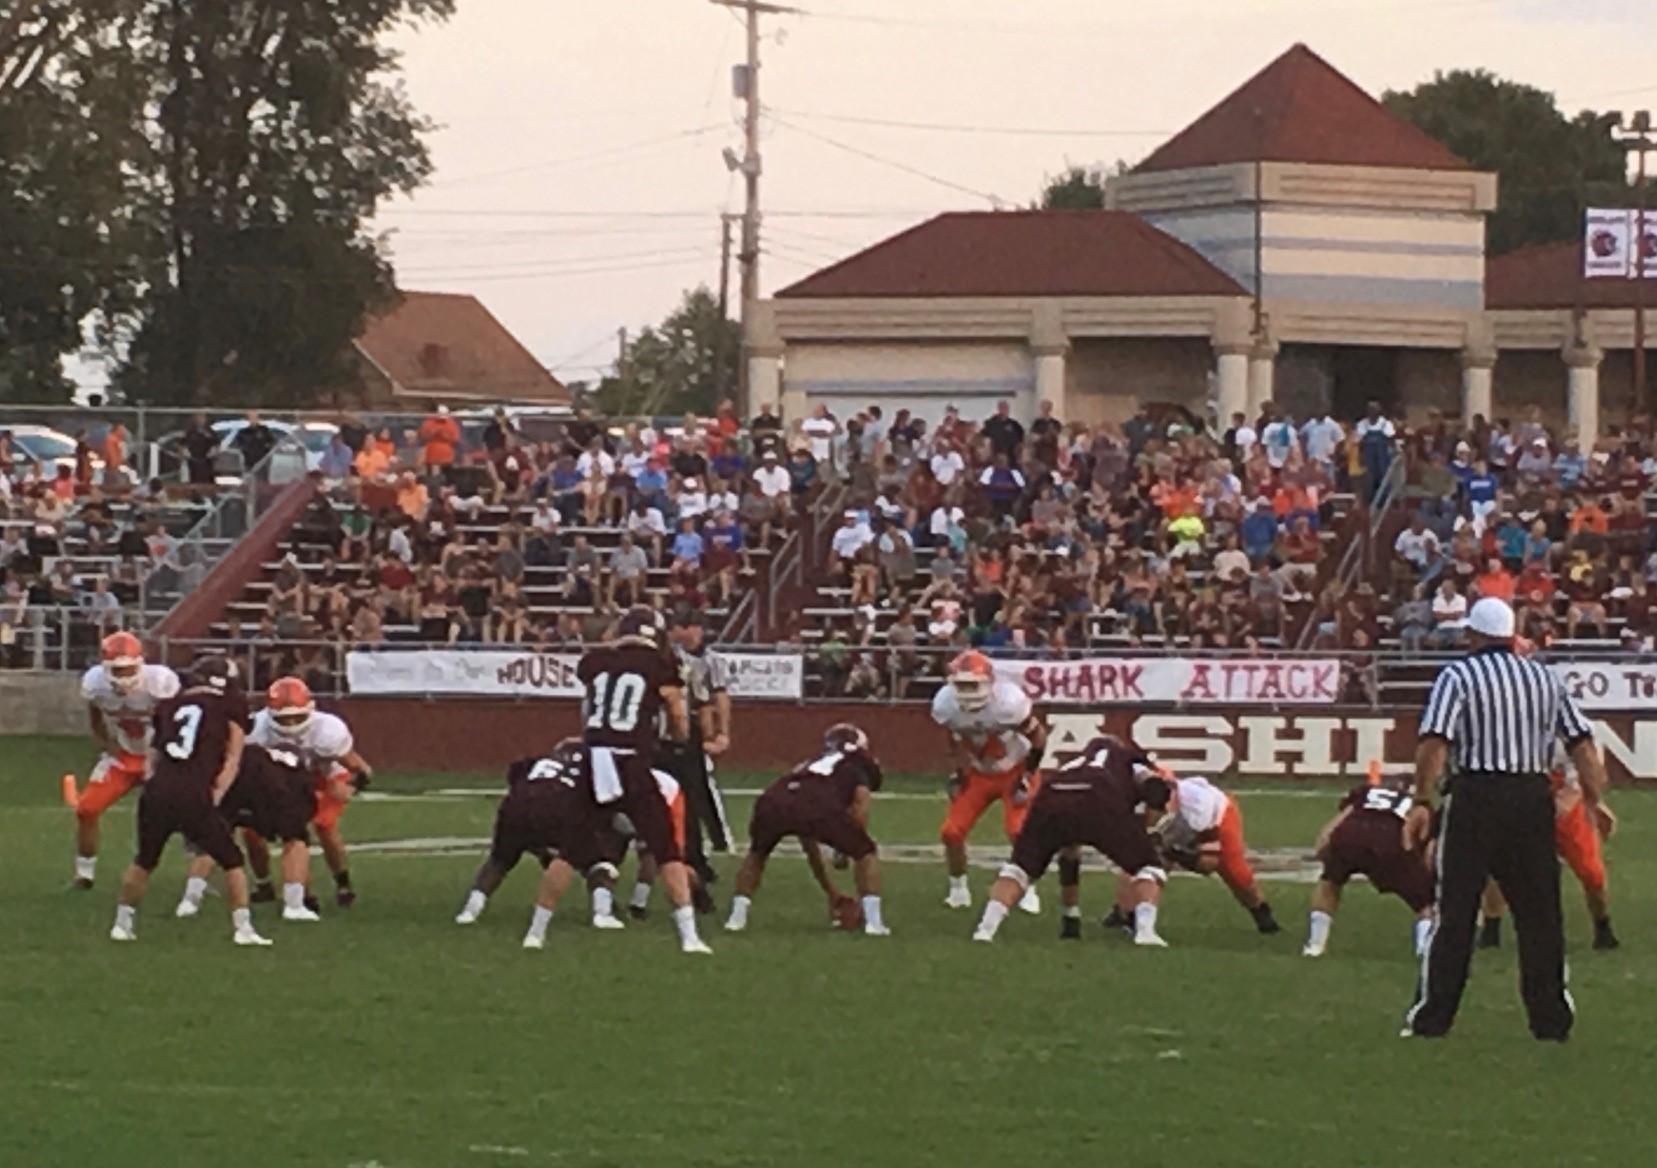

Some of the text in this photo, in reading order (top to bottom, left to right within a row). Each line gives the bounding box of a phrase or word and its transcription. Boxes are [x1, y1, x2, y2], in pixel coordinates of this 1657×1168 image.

[496, 655, 575, 689] HOUSE
[1022, 665, 1335, 700] SHARK ATTACK
[1564, 671, 1609, 699] GO
[586, 671, 646, 732] 10
[166, 704, 203, 760] 3
[1038, 713, 1657, 778] ASHLN
